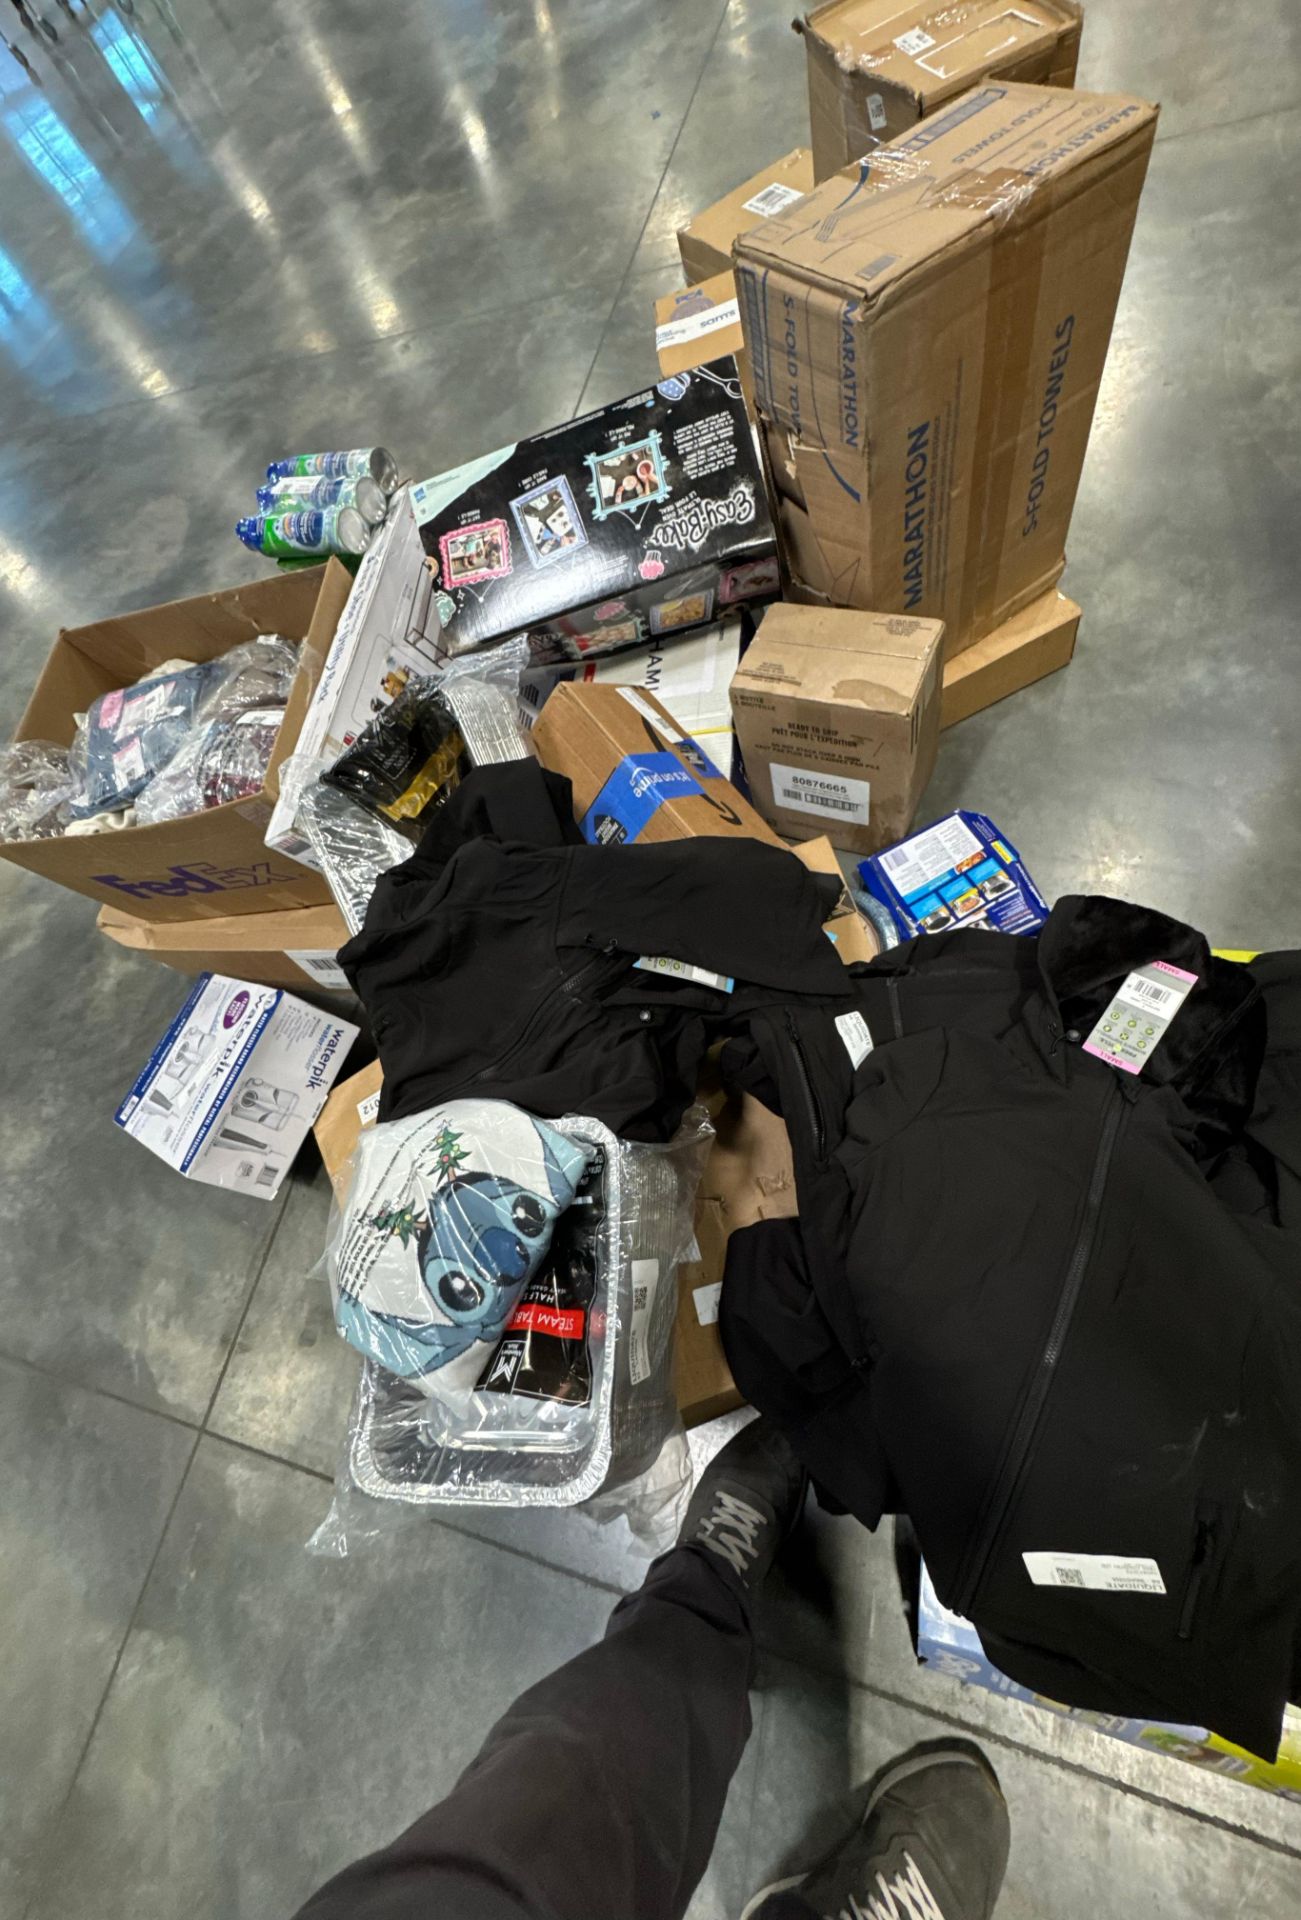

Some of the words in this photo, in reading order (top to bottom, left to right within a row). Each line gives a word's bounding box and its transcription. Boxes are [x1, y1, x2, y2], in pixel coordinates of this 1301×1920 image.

[783, 294, 798, 378] S-FOLD
[1022, 449, 1049, 537] S-FOLD
[1037, 314, 1075, 448] TOWELS
[903, 420, 931, 610] MARATHON
[787, 722, 809, 731] READY
[790, 775, 848, 793] 80876665
[90, 861, 294, 899] FedEx
[210, 989, 269, 1082] waterpik
[302, 1022, 334, 1072] waterflosser
[303, 1027, 352, 1095] waterpik
[1098, 1050, 1124, 1066] SMALL
[529, 1290, 553, 1303] HALF
[537, 1312, 573, 1331] STEAM
[1104, 1581, 1162, 1591] LIQUIDATE
